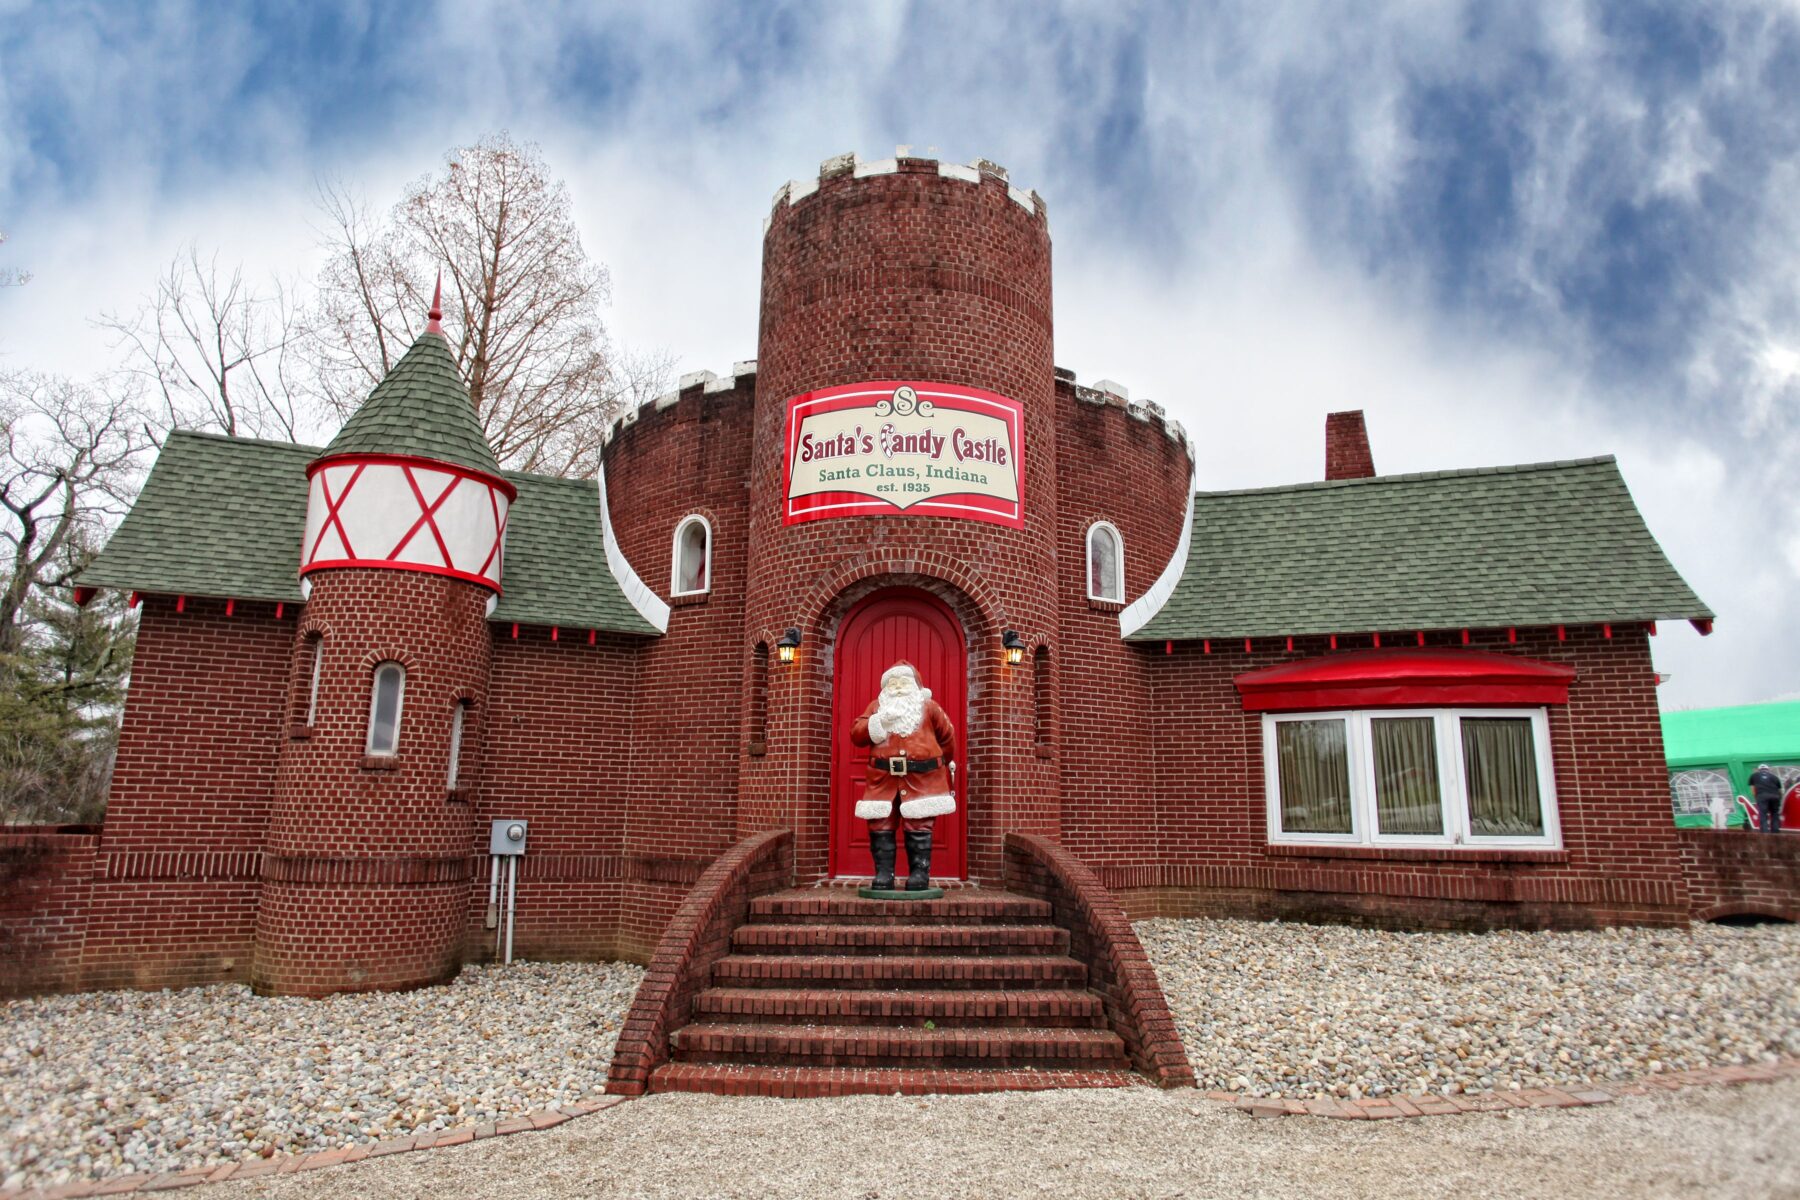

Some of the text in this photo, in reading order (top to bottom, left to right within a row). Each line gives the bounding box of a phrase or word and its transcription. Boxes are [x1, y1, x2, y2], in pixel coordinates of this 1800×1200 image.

[896, 389, 913, 411] S
[801, 423, 1007, 466] Santa's Candy Castle
[819, 464, 988, 485] Santa Claus, Indiana
[876, 483, 931, 493] est. 1935
